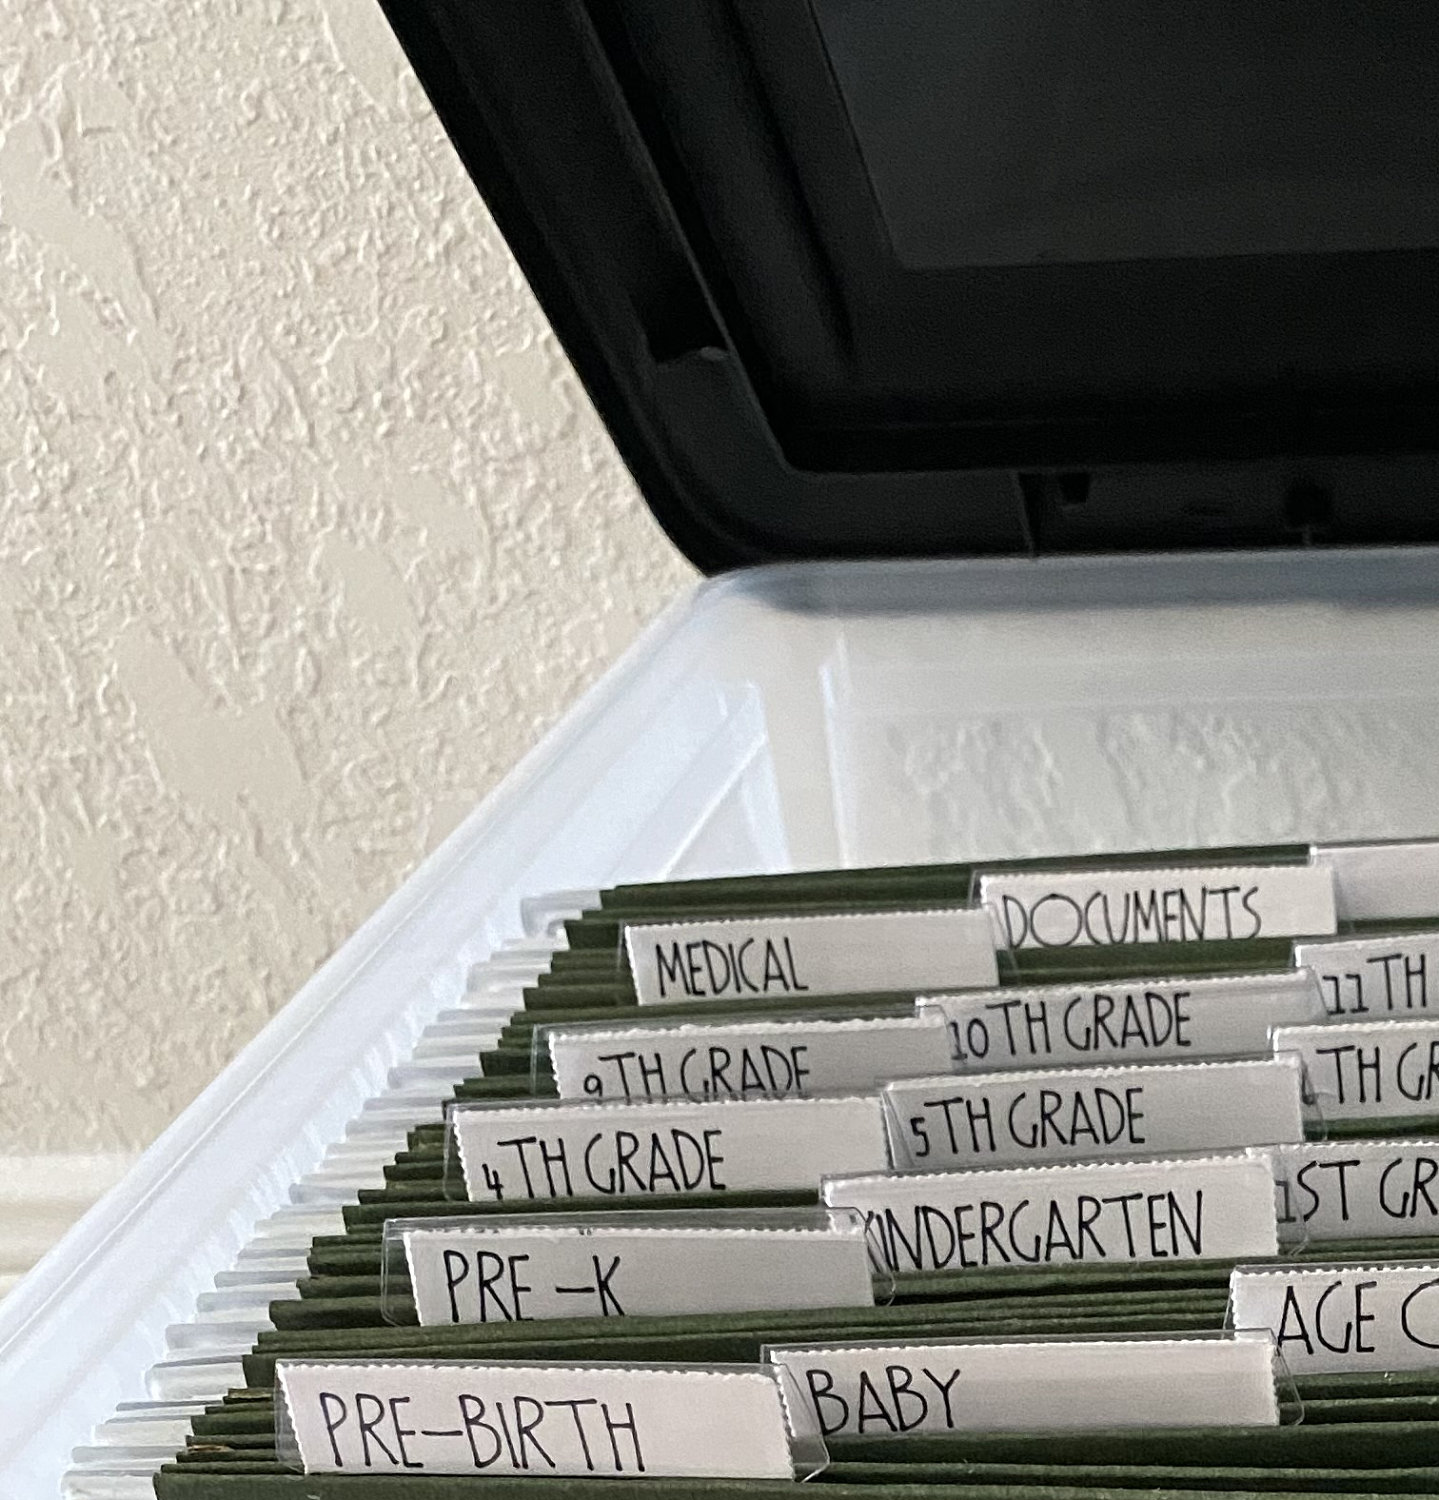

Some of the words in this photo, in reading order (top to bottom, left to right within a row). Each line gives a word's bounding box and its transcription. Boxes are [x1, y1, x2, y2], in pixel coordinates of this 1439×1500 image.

[1002, 886, 1262, 950] DOCUMENTS
[655, 936, 809, 998] MEDICAL
[1322, 953, 1426, 1016] 11TH
[950, 999, 1051, 1062] 10TH
[1064, 991, 1192, 1051] GRADE
[583, 1052, 667, 1104] 9TH
[680, 1045, 810, 1104] GRADE
[910, 1096, 997, 1157] 5TH
[1008, 1087, 1145, 1149] GRADE
[482, 1136, 573, 1200] 4TH
[584, 1128, 727, 1194] GRADE
[1275, 1160, 1361, 1222] 1ST
[1277, 1280, 1378, 1355] AGE
[319, 1391, 646, 1473] PRE-BIRTH
[805, 1365, 961, 1436] BABY
